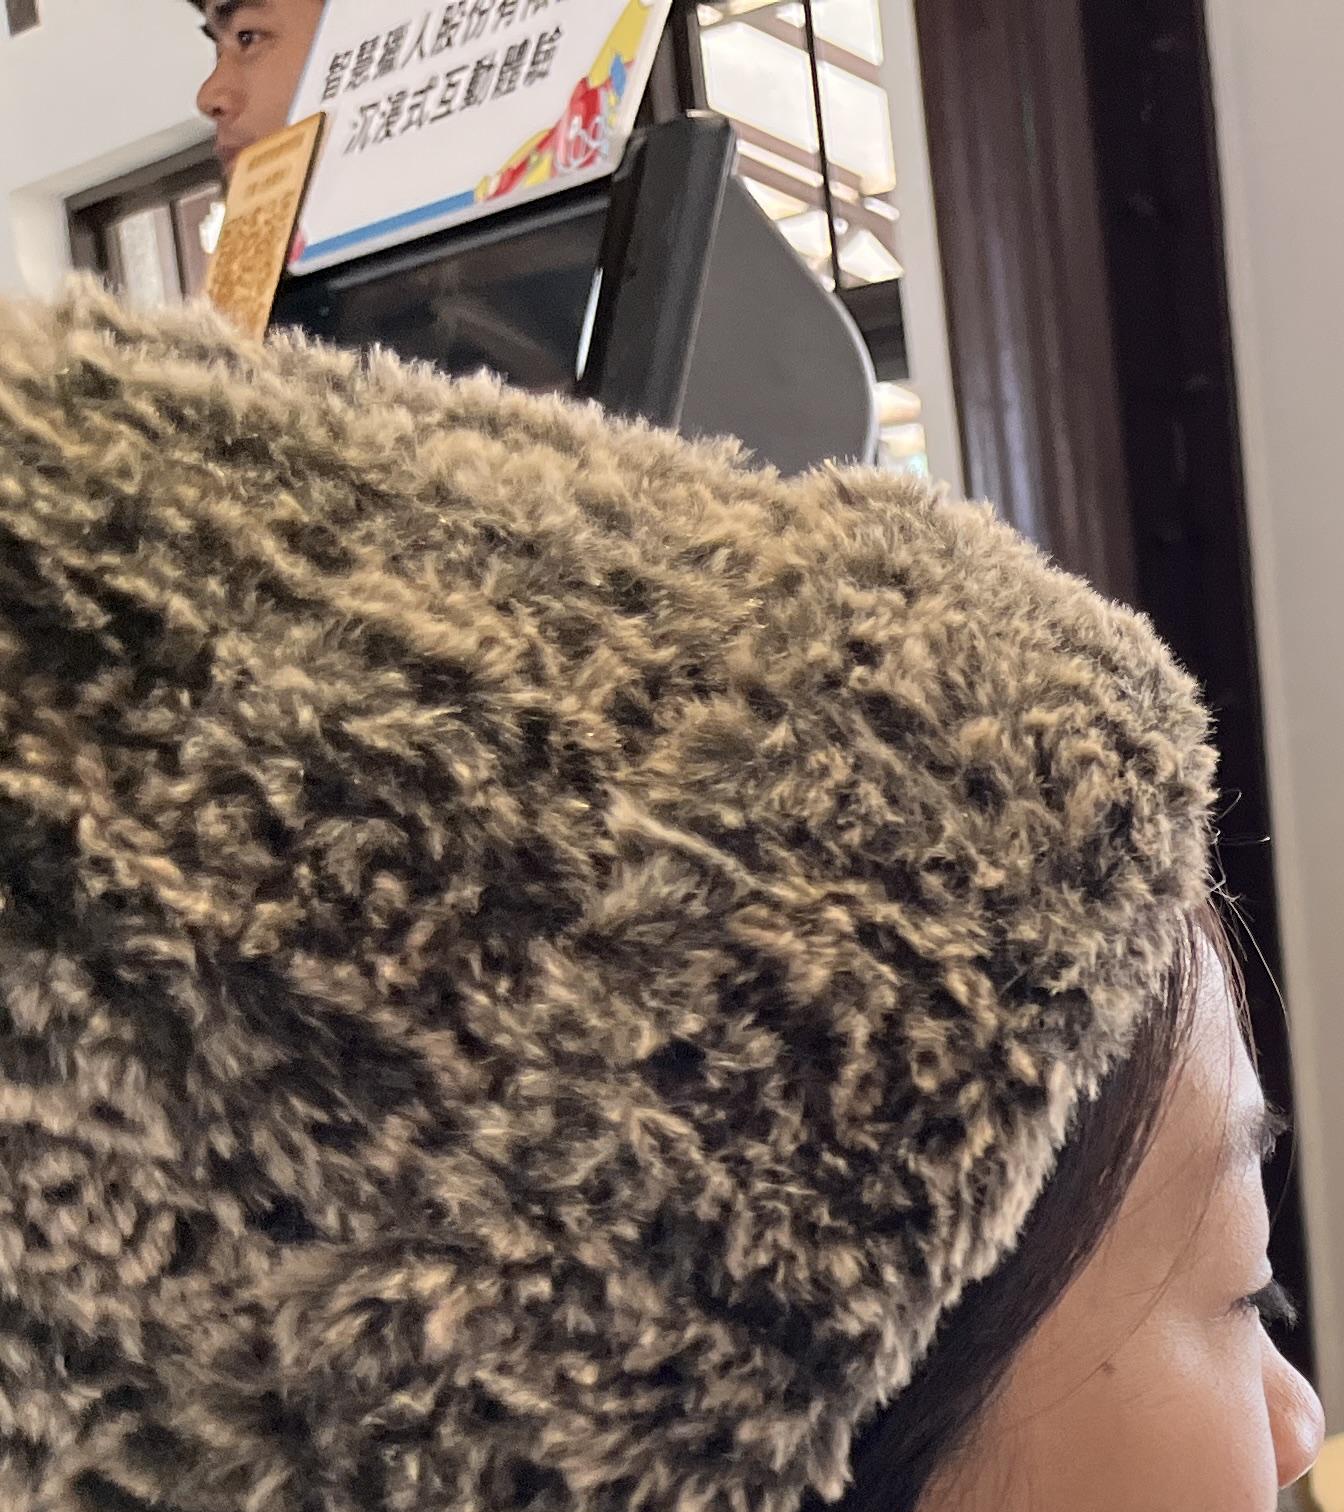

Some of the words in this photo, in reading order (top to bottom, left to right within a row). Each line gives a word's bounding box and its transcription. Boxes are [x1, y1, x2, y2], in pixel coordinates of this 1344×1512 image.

[344, 26, 564, 154] 沉浸式互動體驗
